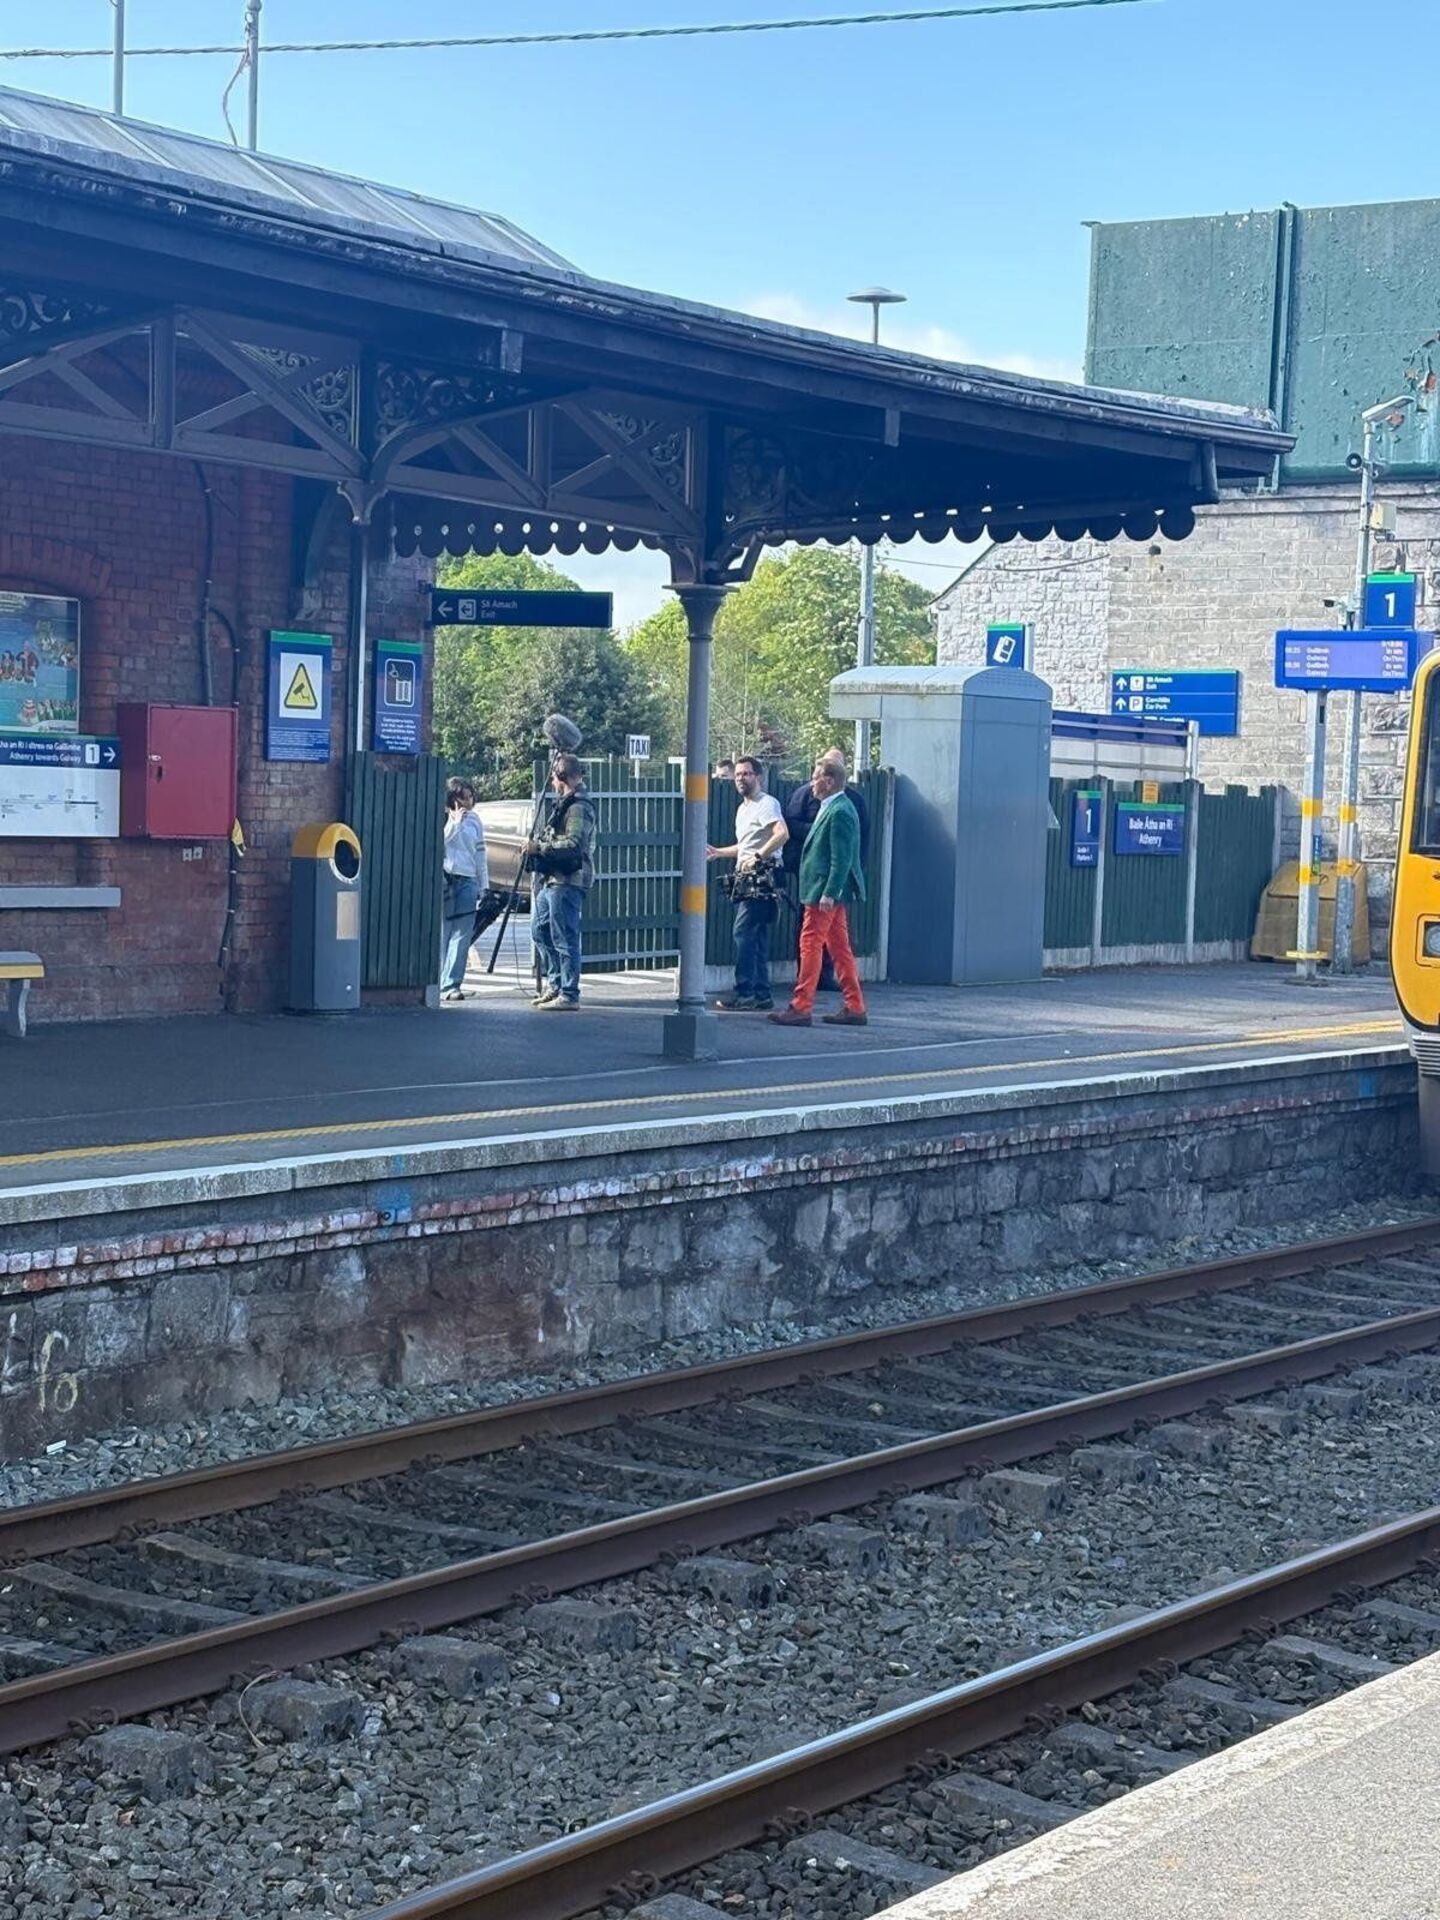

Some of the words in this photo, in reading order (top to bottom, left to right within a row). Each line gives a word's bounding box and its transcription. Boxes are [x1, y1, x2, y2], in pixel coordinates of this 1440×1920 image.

[1385, 592, 1395, 618] 1
[9, 751, 34, 762] Athenry
[59, 753, 81, 764] Galway
[89, 747, 95, 762] 1
[1086, 808, 1092, 834] 1
[1129, 817, 1144, 830] Baile
[1159, 821, 1166, 831] an
[1138, 833, 1162, 848] Athenry
